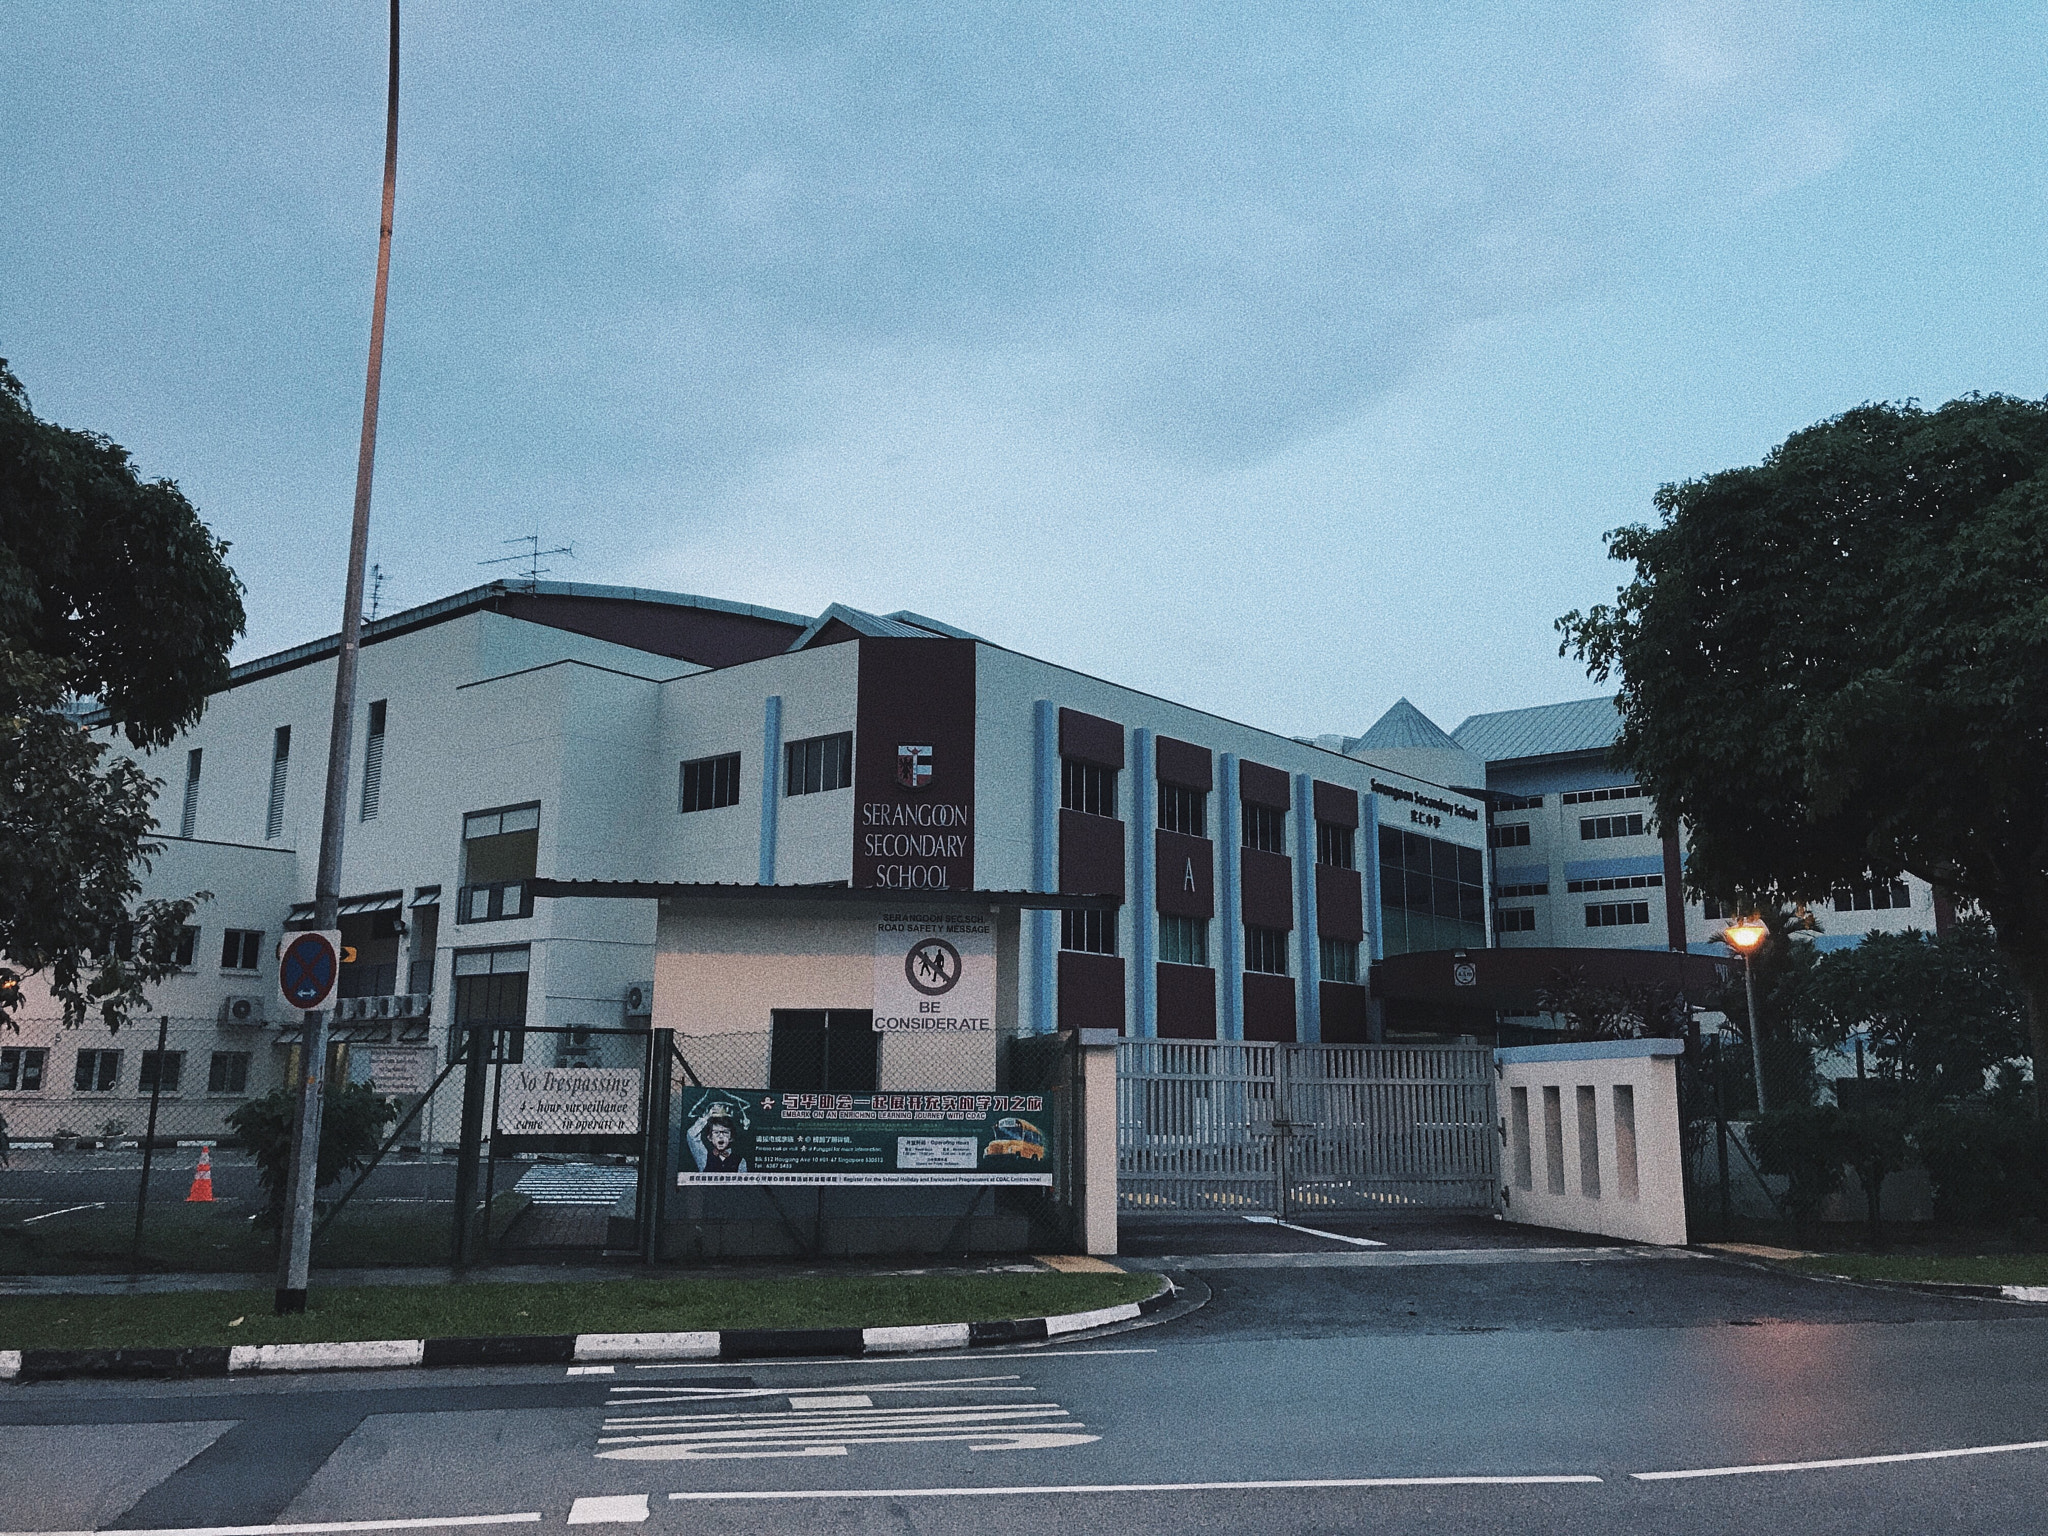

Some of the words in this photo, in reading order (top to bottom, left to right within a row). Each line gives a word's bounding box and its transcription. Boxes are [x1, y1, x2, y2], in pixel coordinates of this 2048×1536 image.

[1370, 778, 1414, 802] Serangoon
[1414, 791, 1453, 816] Secondary
[1454, 803, 1478, 821] School
[863, 803, 967, 826] SERANGOON
[865, 834, 967, 857] SECONDARY
[876, 865, 950, 889] SCHOOL
[1184, 857, 1195, 892] A
[882, 913, 943, 923] SERANGOON
[878, 924, 905, 932] ROAD
[907, 924, 944, 933] SAFETY
[946, 925, 990, 934] MESSAGE
[919, 1002, 941, 1014] BE
[875, 1017, 990, 1031] CONSIDERATE
[516, 1071, 536, 1092] No
[544, 1071, 630, 1097] Trespassing
[537, 1100, 561, 1113] hour
[565, 1100, 628, 1113] surveillance
[781, 1094, 1043, 1111] 与华助会一起展开充实的学习之旅
[781, 1110, 811, 1119] EMBARK
[812, 1110, 824, 1119] ON
[826, 1111, 837, 1119] AN
[839, 1111, 876, 1119] ENRICHING
[878, 1111, 912, 1120] LEARNING
[914, 1111, 945, 1120] JOURNEY
[947, 1111, 964, 1120] WITH
[965, 1112, 986, 1120] CDAC
[562, 1117, 572, 1129] in
[774, 1156, 799, 1164] Hougang
